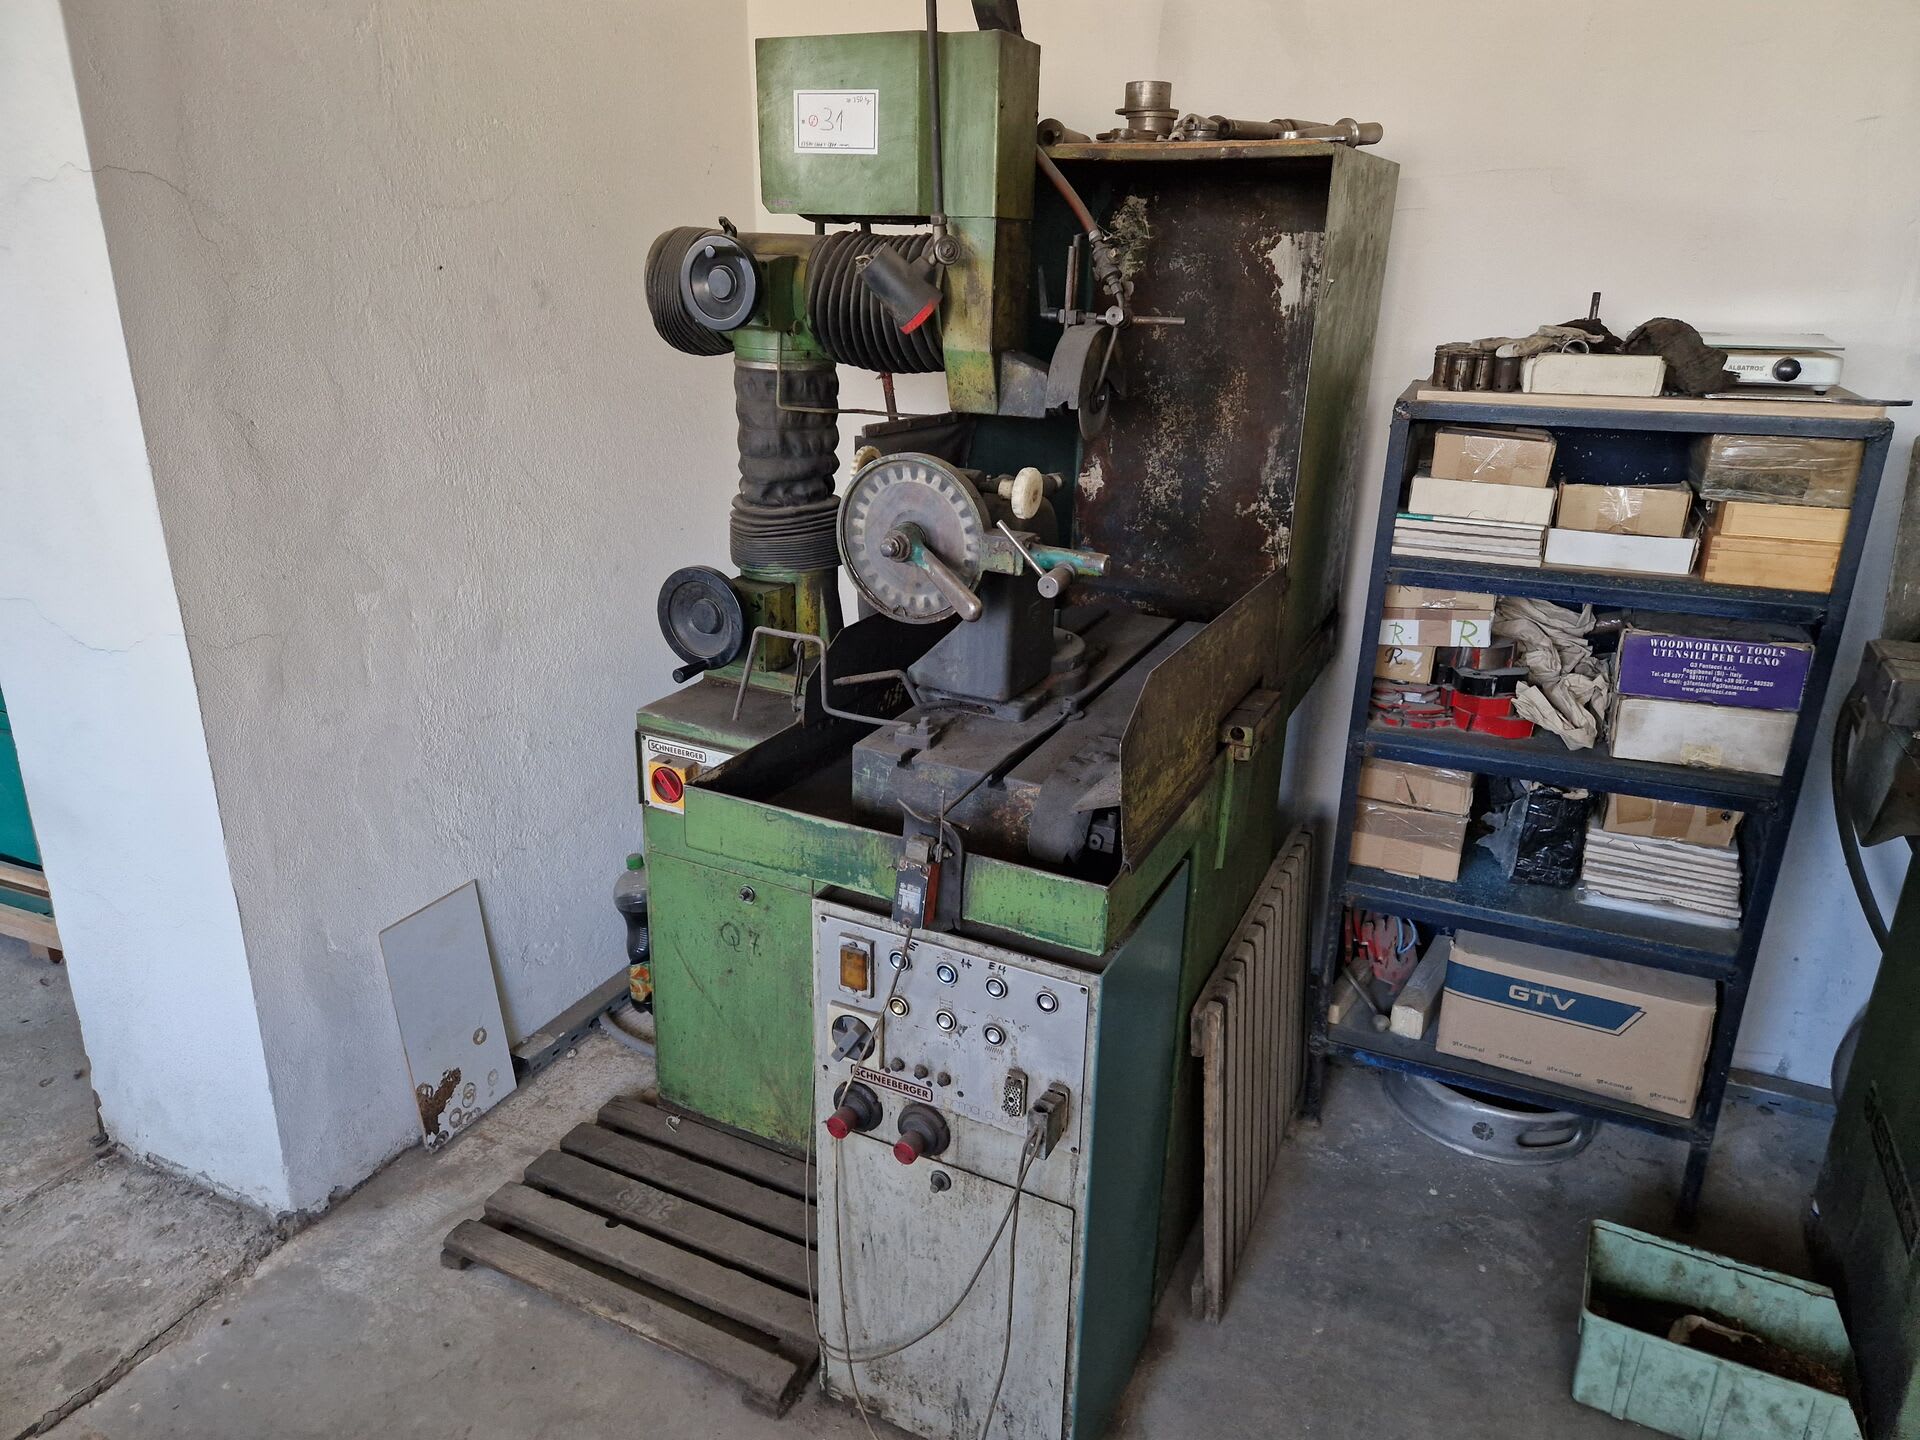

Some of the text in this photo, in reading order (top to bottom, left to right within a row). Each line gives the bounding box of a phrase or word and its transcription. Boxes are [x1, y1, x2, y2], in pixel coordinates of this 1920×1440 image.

[1728, 364, 1765, 372] ALBATROS
[1650, 638, 1787, 658] WOODWORKING TOOLS
[1653, 648, 1780, 667] UTENSILI PER LEGNO
[650, 742, 704, 761] SCHNEEBERGER
[1508, 984, 1577, 1011] GTV
[1452, 1041, 1485, 1053] gtv.com.pl
[1498, 1053, 1532, 1065] gtv.com.pl
[855, 1067, 929, 1099] SCHNEEBERGER
